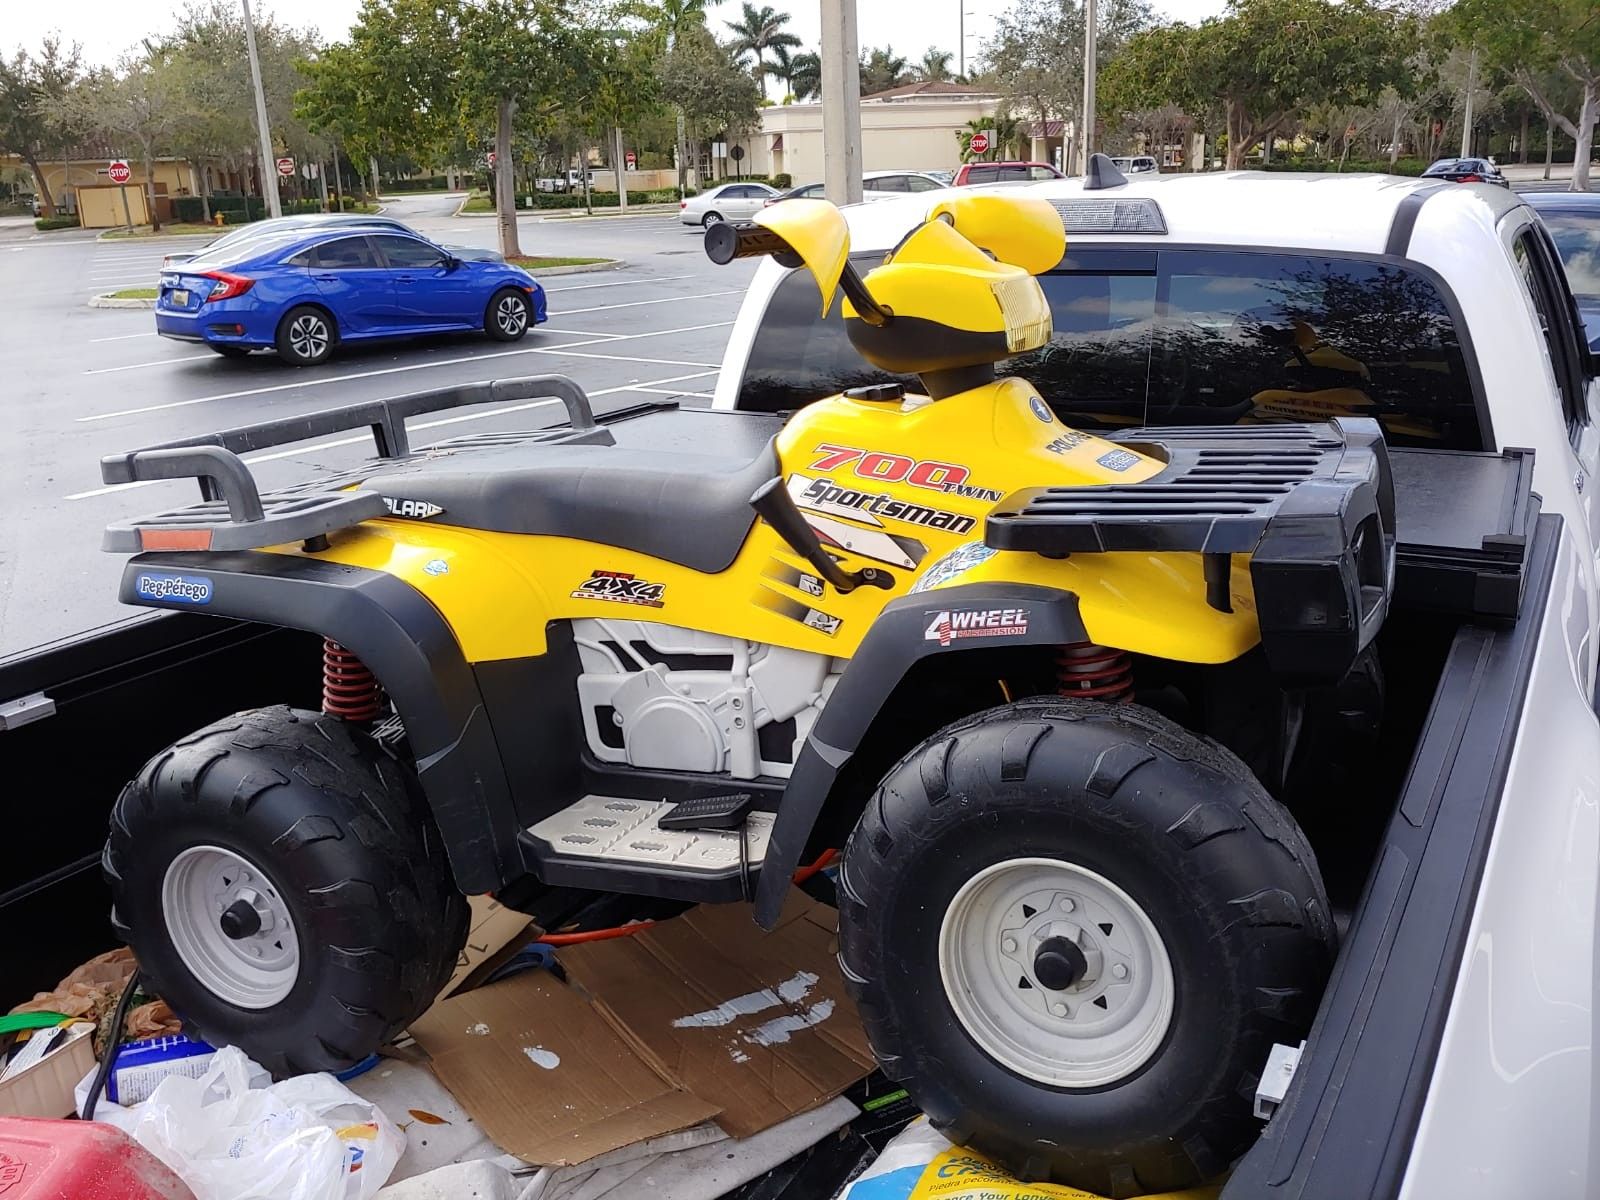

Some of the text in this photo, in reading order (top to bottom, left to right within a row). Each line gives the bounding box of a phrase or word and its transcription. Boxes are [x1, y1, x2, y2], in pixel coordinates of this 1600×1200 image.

[971, 139, 987, 148] STOP
[110, 168, 129, 178] STOP
[1045, 431, 1092, 456] POLAR
[807, 443, 1005, 503] 700 TWIN
[803, 478, 977, 535] Sportsman
[580, 576, 666, 601] 4X4
[924, 608, 1028, 647] 4 WHEEL
[928, 1180, 961, 1192] Piedra
